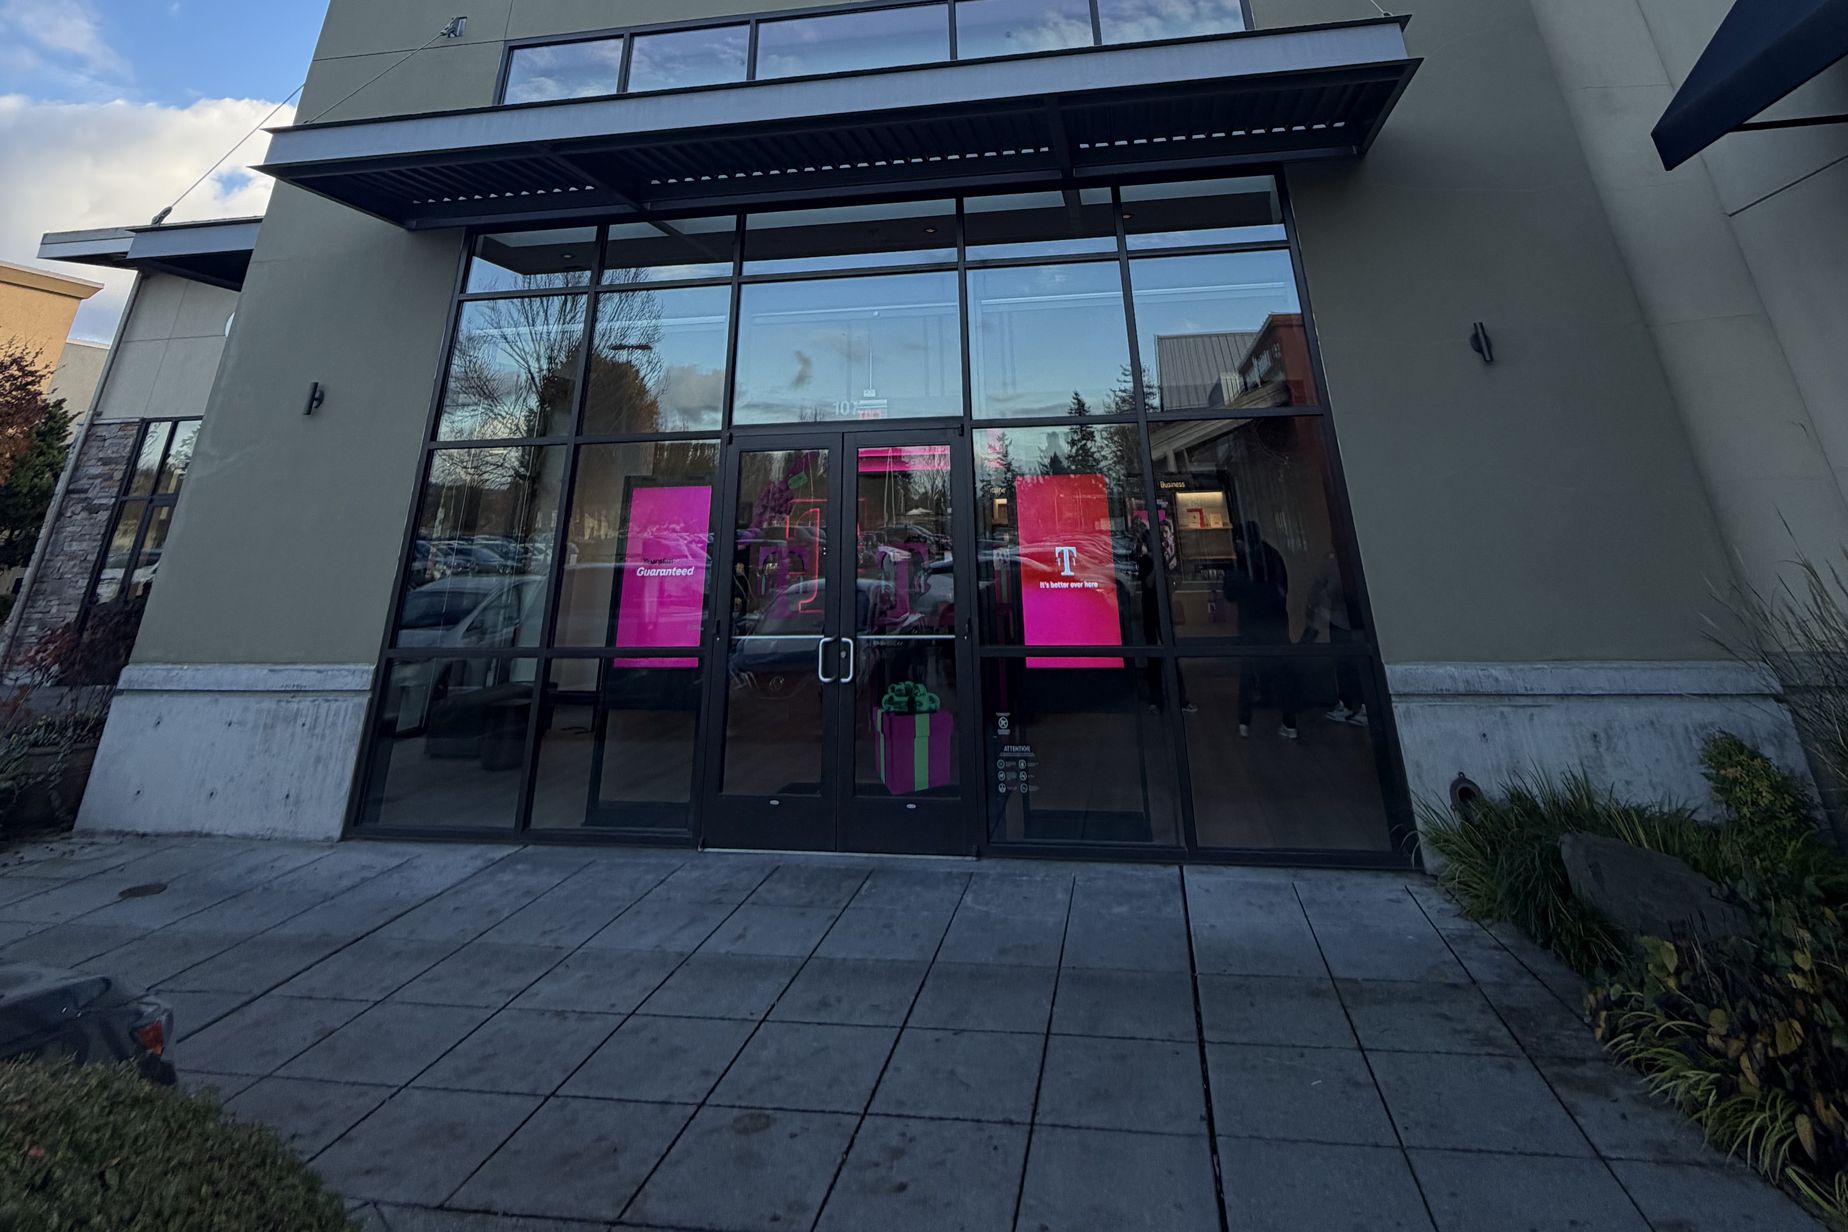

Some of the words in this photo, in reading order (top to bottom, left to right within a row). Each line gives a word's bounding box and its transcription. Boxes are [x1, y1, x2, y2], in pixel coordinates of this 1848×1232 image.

[1159, 480, 1186, 489] Business
[1055, 546, 1077, 576] T
[636, 566, 695, 577] Guaranteed
[1050, 581, 1069, 589] better
[1084, 580, 1099, 588] here
[1003, 744, 1031, 753] ATTENTION
